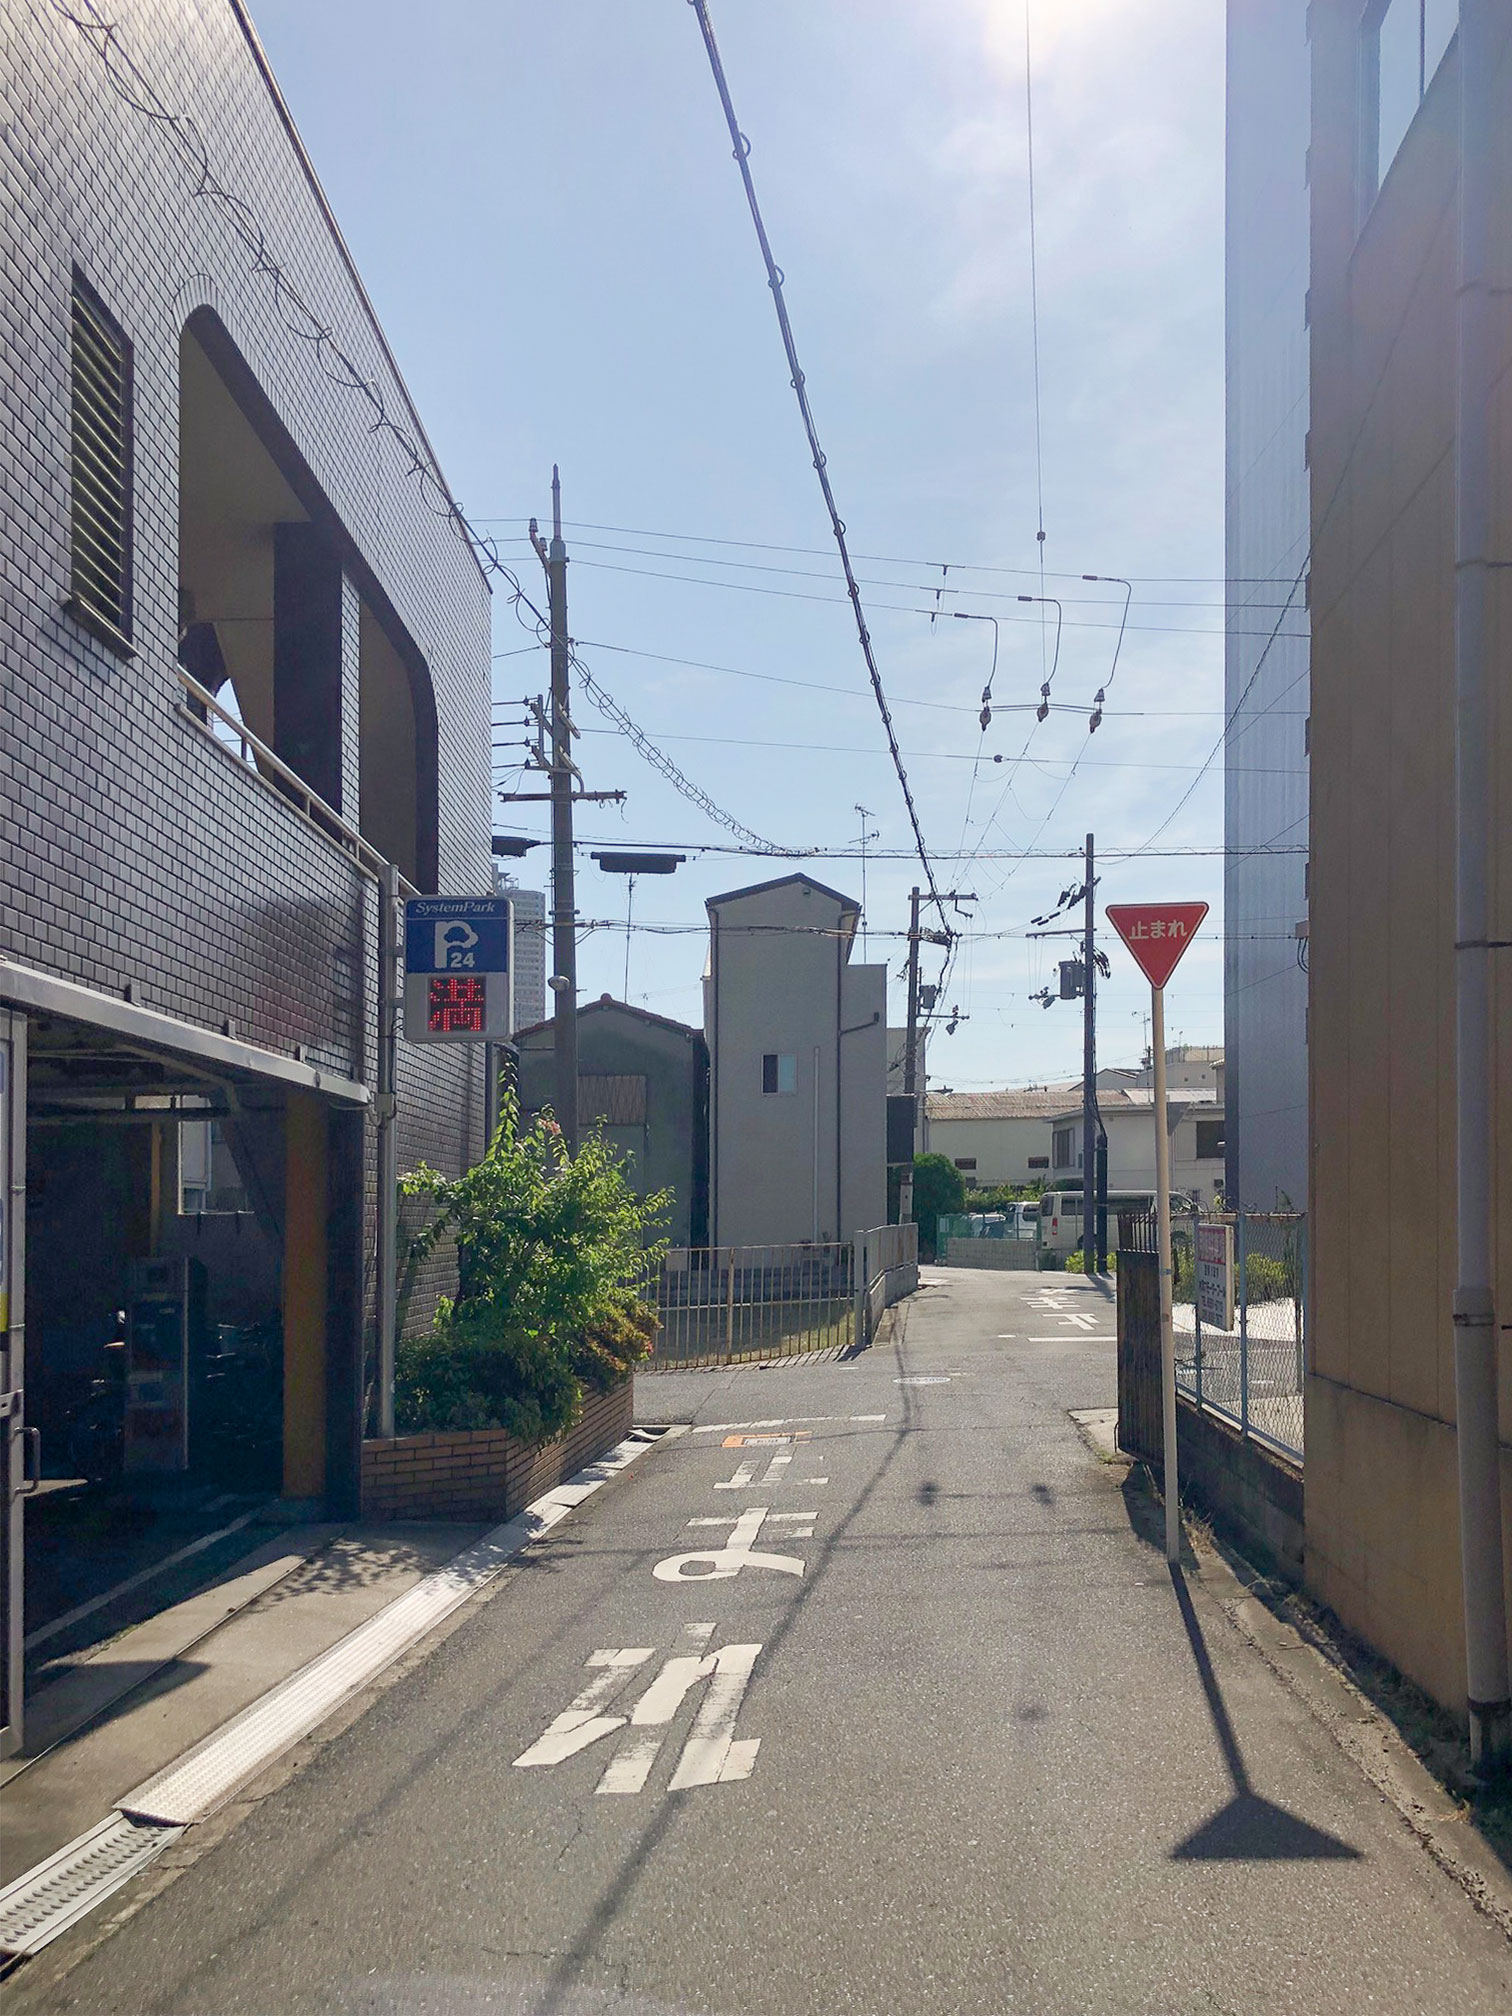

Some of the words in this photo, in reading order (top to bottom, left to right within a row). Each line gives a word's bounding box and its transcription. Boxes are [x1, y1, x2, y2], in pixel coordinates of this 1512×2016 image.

[416, 902, 496, 915] SystemPark
[434, 920, 478, 969] P
[1129, 920, 1187, 940] 止まれ
[450, 952, 476, 968] 24
[428, 979, 485, 1031] 満
[511, 1443, 829, 1793] 止まれ
